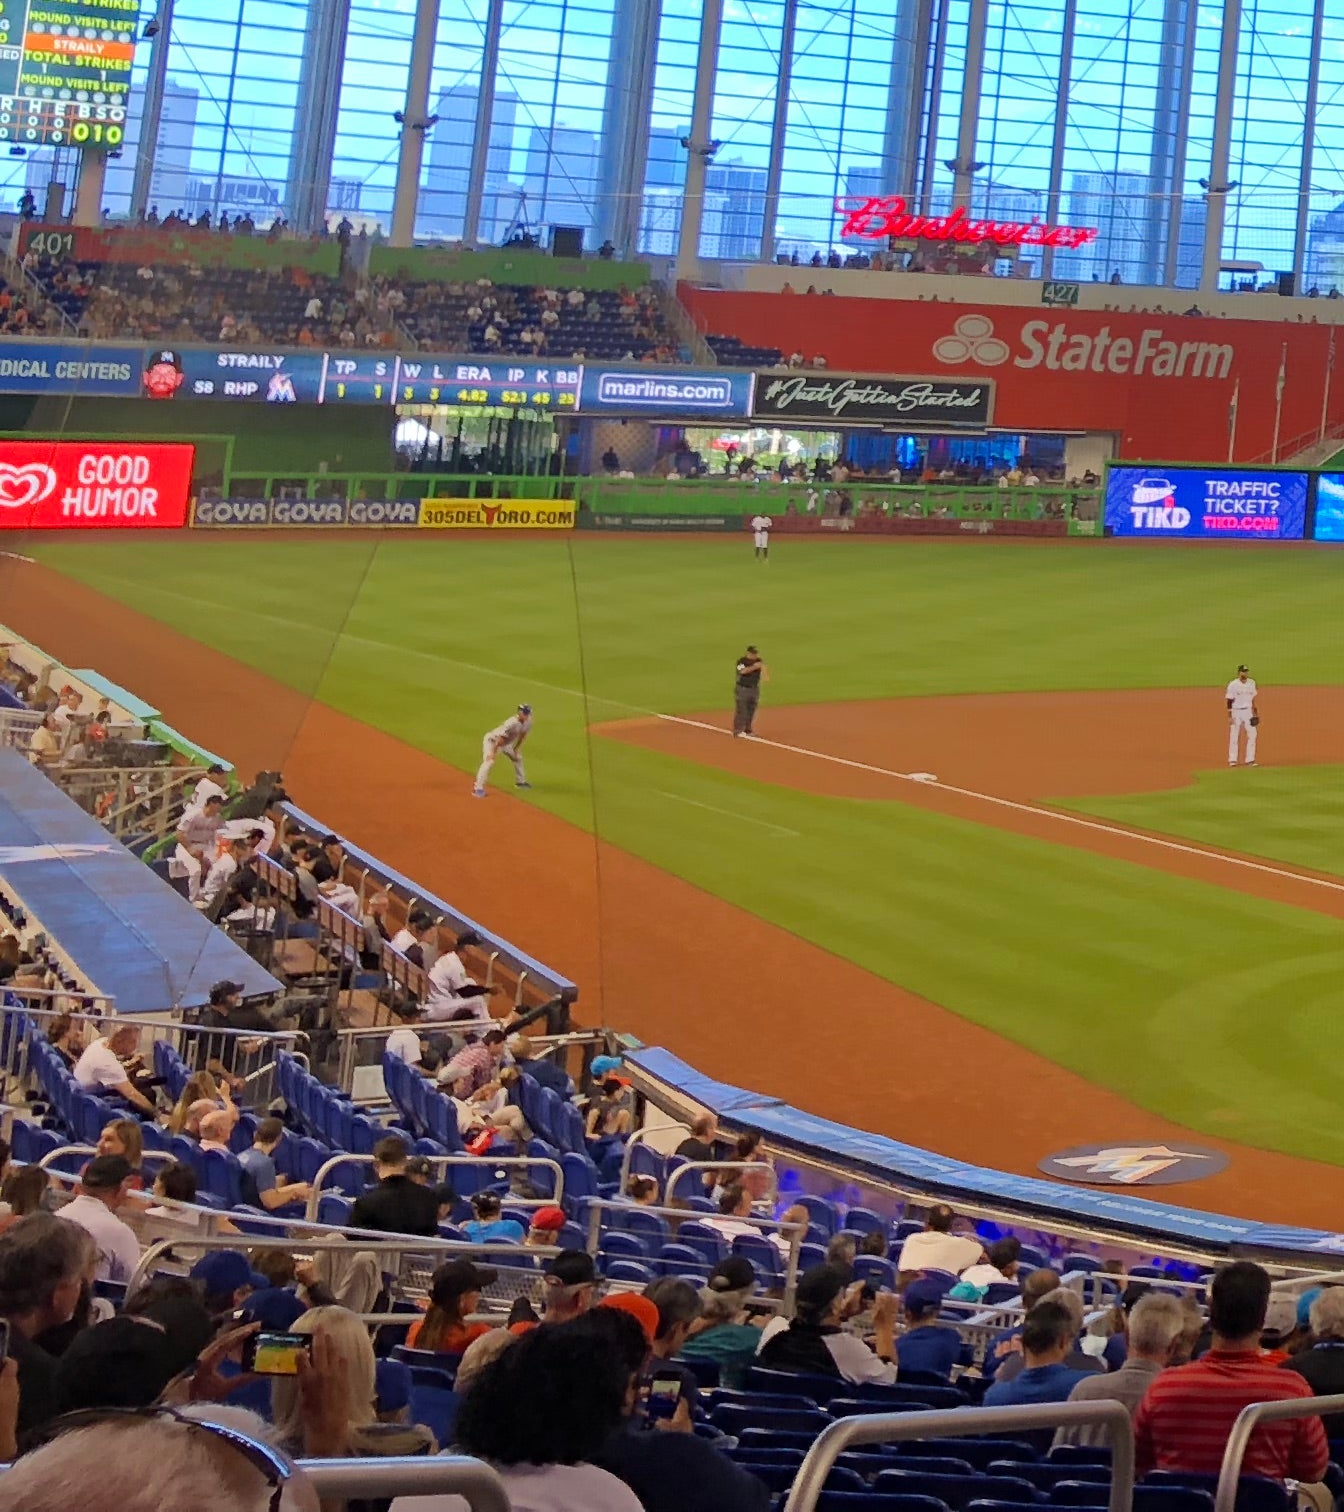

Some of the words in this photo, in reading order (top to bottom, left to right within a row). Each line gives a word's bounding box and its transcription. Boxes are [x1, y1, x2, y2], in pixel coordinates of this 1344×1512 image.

[29, 11, 71, 25] MOUND
[74, 15, 108, 29] VISITS
[110, 20, 136, 32] LEFT
[54, 39, 105, 54] STRAILY
[24, 50, 70, 65] TOTAL
[75, 57, 131, 71] STRIKES
[21, 73, 63, 87] MOUND
[66, 78, 100, 89] VISITS
[103, 82, 128, 93] LEFT
[834, 195, 1099, 249] Budweiser
[30, 232, 73, 255] 401
[1045, 284, 1077, 302] 427
[55, 361, 131, 381] CENTERS
[217, 353, 285, 369] STRAILY
[334, 360, 357, 375] TP
[375, 363, 387, 376] S
[403, 363, 422, 378] W
[433, 365, 444, 379] L
[457, 365, 492, 381] ERA
[508, 368, 525, 382] IP
[536, 369, 549, 383] K
[556, 371, 578, 384] BB
[224, 381, 258, 396] RHP
[337, 383, 345, 398] 1
[374, 384, 382, 399] 1
[604, 378, 725, 400] marlins.com
[78, 455, 150, 485] GOOD
[1205, 480, 1281, 497] TRAFFIC
[62, 487, 158, 517] HUMOR
[197, 502, 267, 522] GOYA
[274, 502, 344, 522] GOYA
[350, 502, 417, 522] GOYA
[1204, 498, 1280, 515] TICKET?
[1130, 506, 1190, 529] TIKD
[1203, 516, 1278, 531] TIKD.COM
